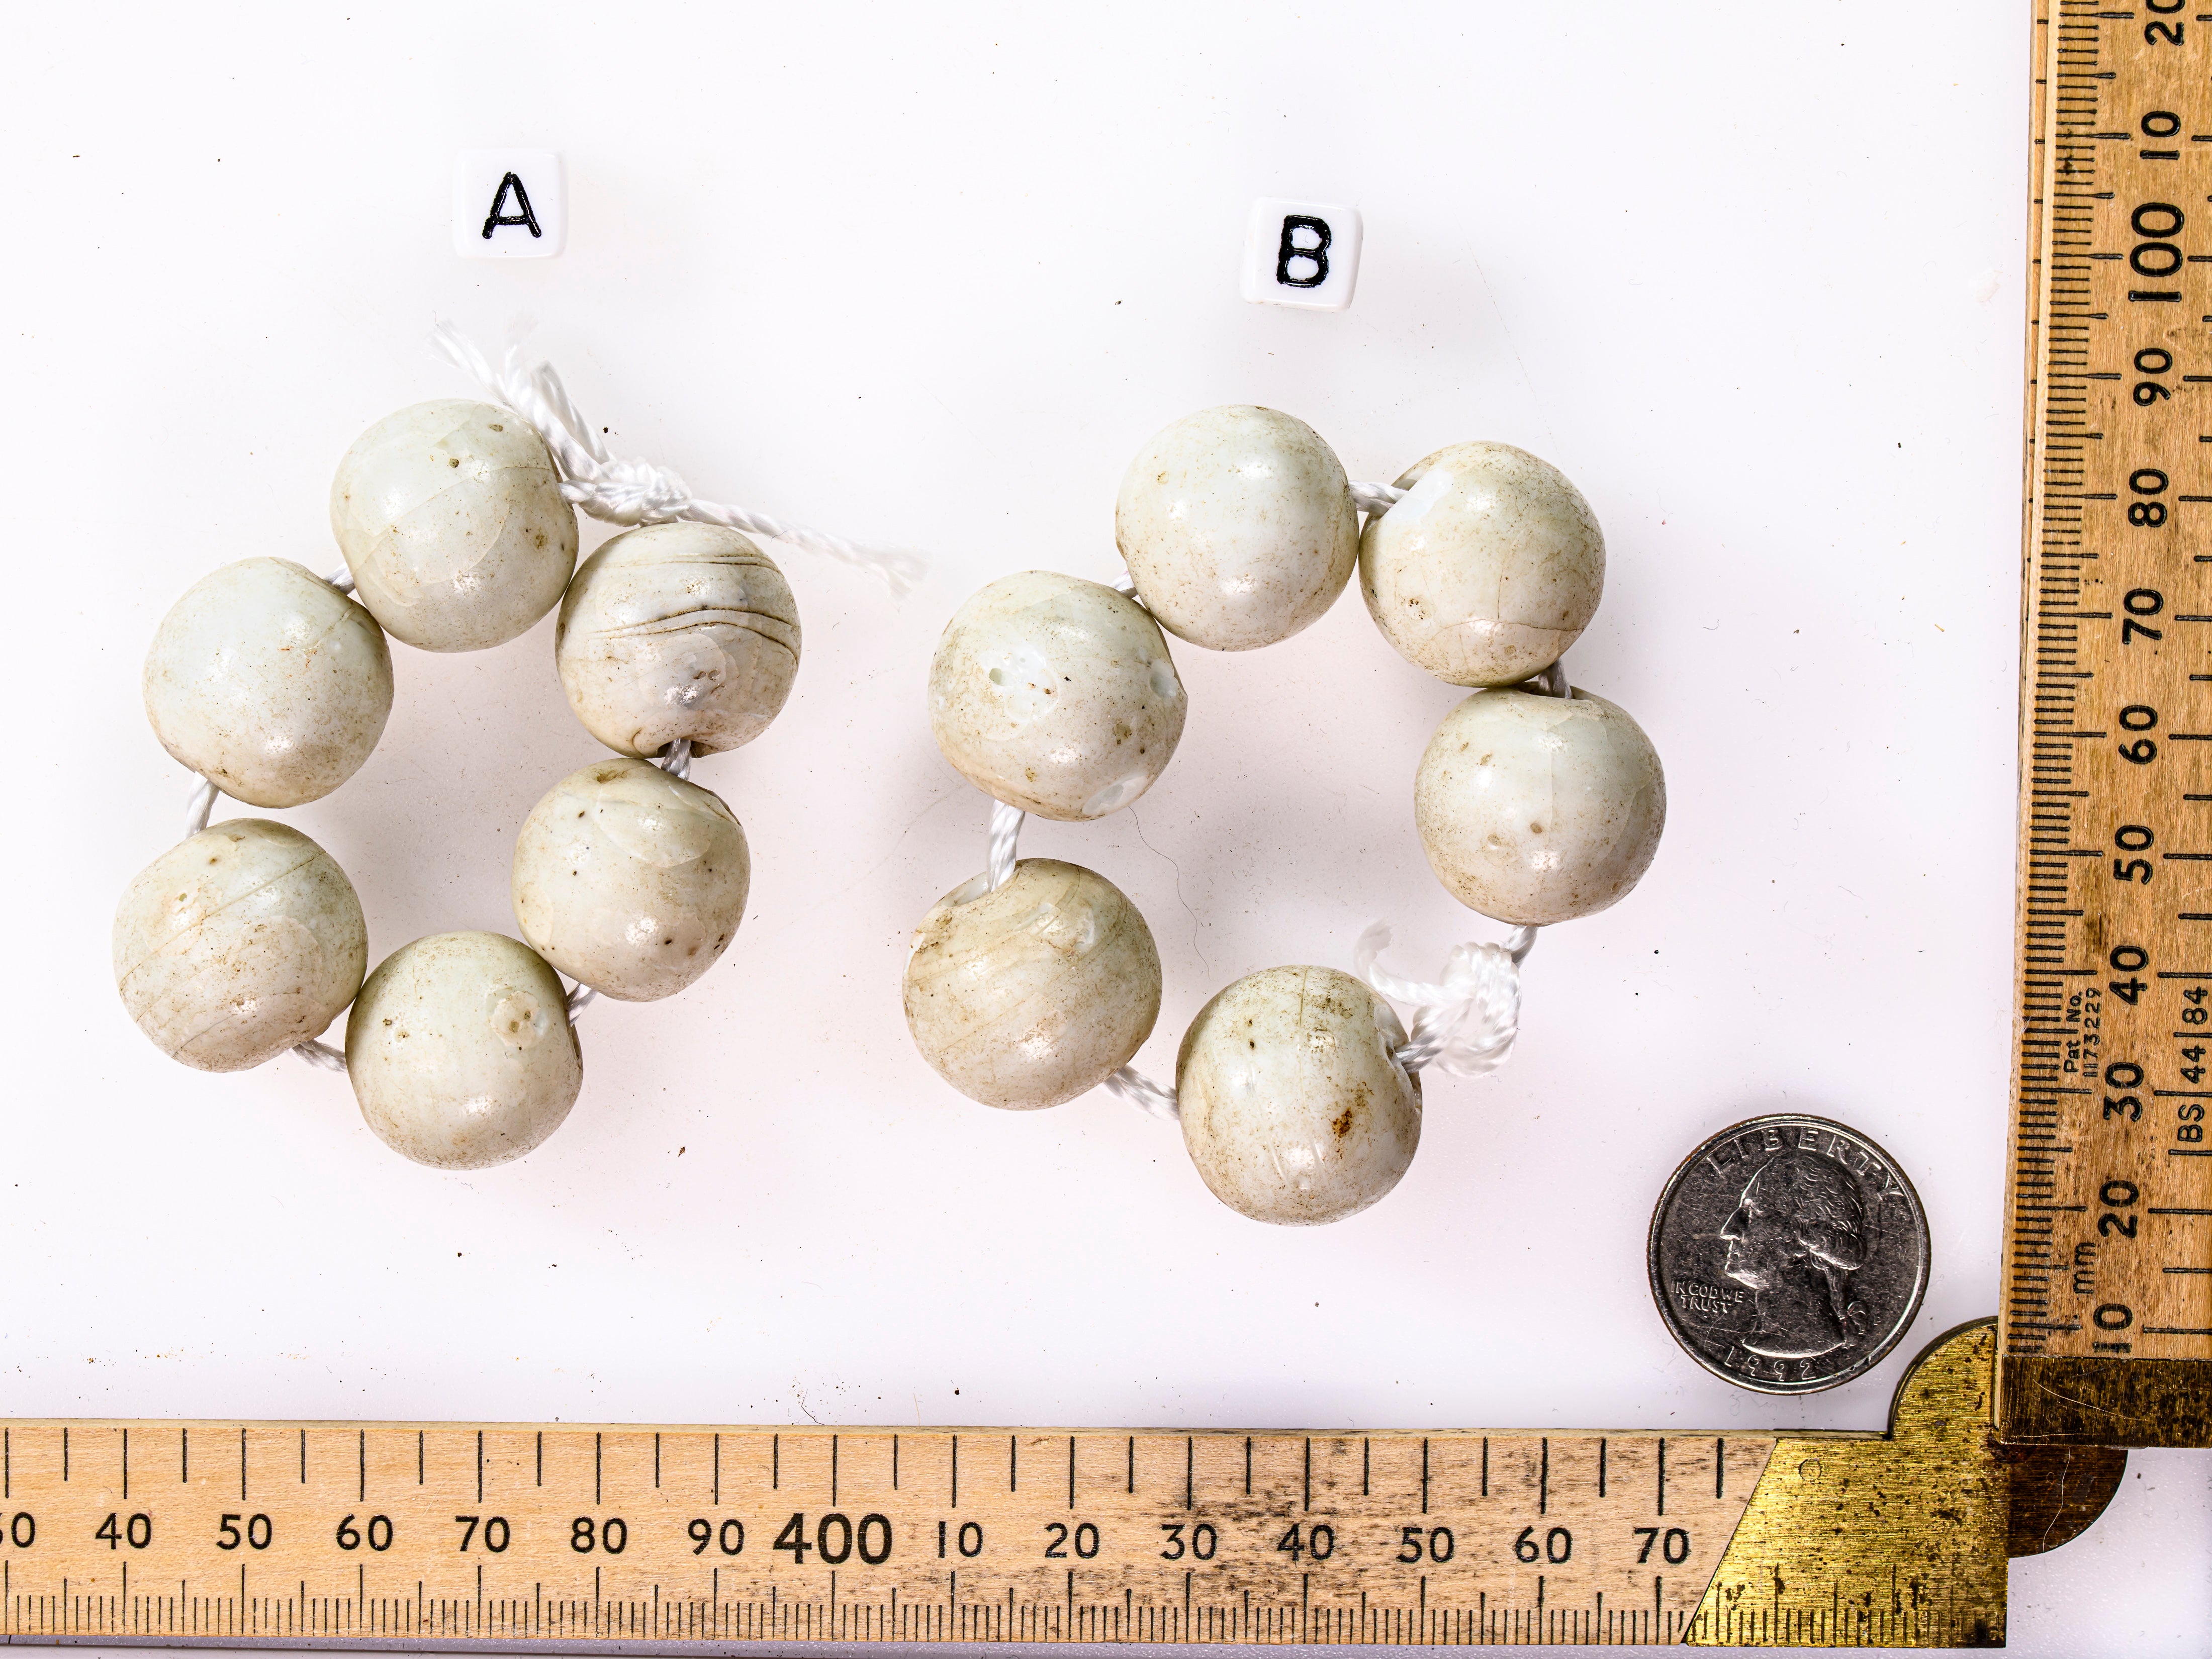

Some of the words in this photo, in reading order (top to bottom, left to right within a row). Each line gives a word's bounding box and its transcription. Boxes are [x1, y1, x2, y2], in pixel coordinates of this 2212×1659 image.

[2140, 110, 2181, 160] 10
[482, 171, 541, 239] A
[1276, 215, 1332, 289] B
[2128, 202, 2185, 303] 100
[2133, 348, 2173, 407] 90
[2128, 468, 2169, 528] 80
[2122, 588, 2164, 645] 70
[2118, 705, 2158, 765] 60
[2113, 824, 2154, 885] 50
[2108, 945, 2149, 1006] 40
[2066, 991, 2082, 1023] No.
[2082, 987, 2101, 1078] 1173229
[2063, 1040, 2081, 1073] Pat
[2102, 1062, 2144, 1123] 30
[2177, 1104, 2205, 1142] BS
[1707, 1127, 1904, 1202] LIBERTY
[2097, 1179, 2140, 1239] 20
[1671, 1281, 1685, 1294] IN
[1689, 1282, 1718, 1299] GOD
[1721, 1288, 1744, 1303] WE
[2073, 1242, 2096, 1294] mm
[1681, 1294, 1731, 1314] TRUST
[2092, 1303, 2133, 1353] 10
[1724, 1346, 1816, 1381] 1992
[0, 1512, 36, 1548] 0
[95, 1513, 152, 1550] 40
[216, 1514, 272, 1550] 50
[336, 1513, 393, 1551] 60
[455, 1516, 510, 1553] 70
[571, 1517, 627, 1554] 80
[688, 1518, 745, 1556] 90
[773, 1512, 892, 1565] 400
[938, 1521, 983, 1558] 10
[1044, 1522, 1100, 1559] 20
[1160, 1523, 1218, 1561] 30
[1276, 1523, 1335, 1562] 40
[1396, 1525, 1454, 1564] 50
[1512, 1526, 1572, 1564] 60
[1633, 1527, 1690, 1564] 70
